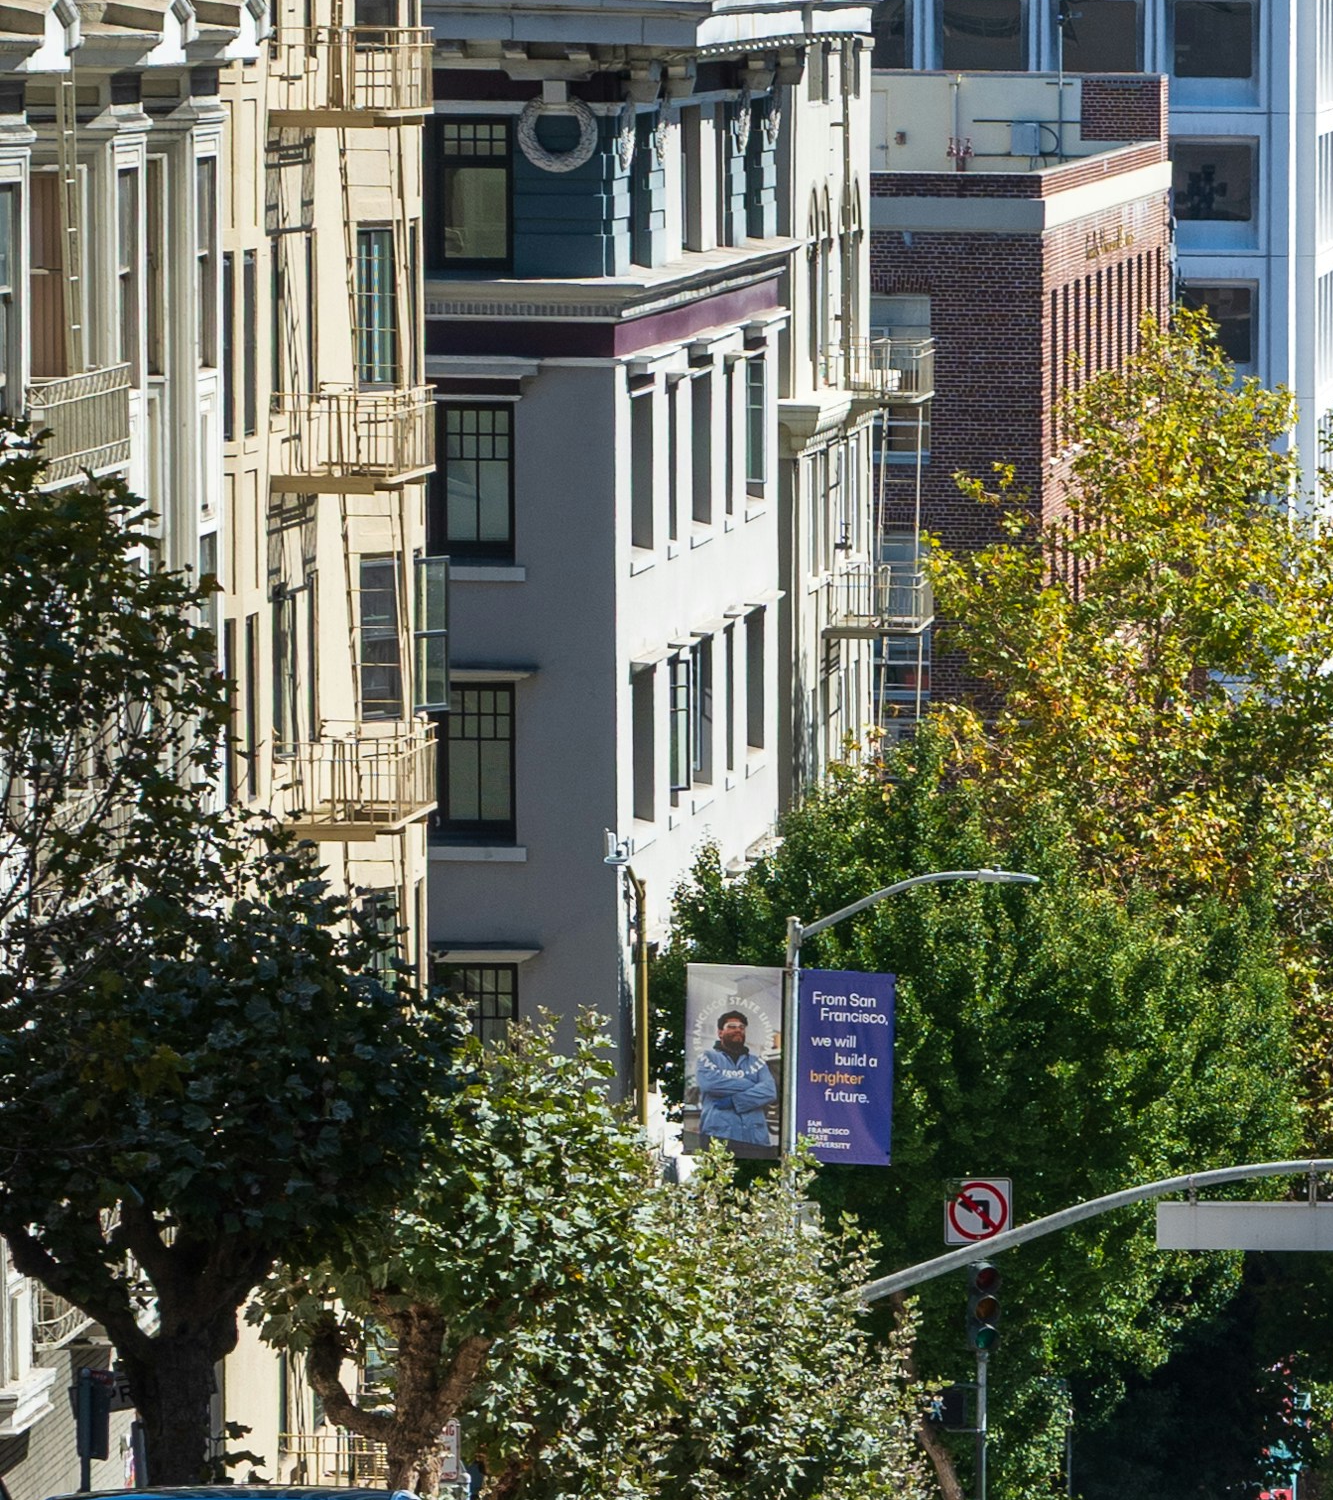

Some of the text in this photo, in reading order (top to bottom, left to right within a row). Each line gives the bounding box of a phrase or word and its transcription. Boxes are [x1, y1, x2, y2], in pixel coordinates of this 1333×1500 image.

[728, 996, 761, 1014] STATE
[812, 991, 877, 1008] From San
[820, 1007, 889, 1026] Francisco,
[810, 1035, 857, 1049] we will
[834, 1052, 879, 1068] build a
[810, 1069, 866, 1086] brighter
[824, 1088, 871, 1104] future.
[807, 1126, 851, 1136] FRANCISCO
